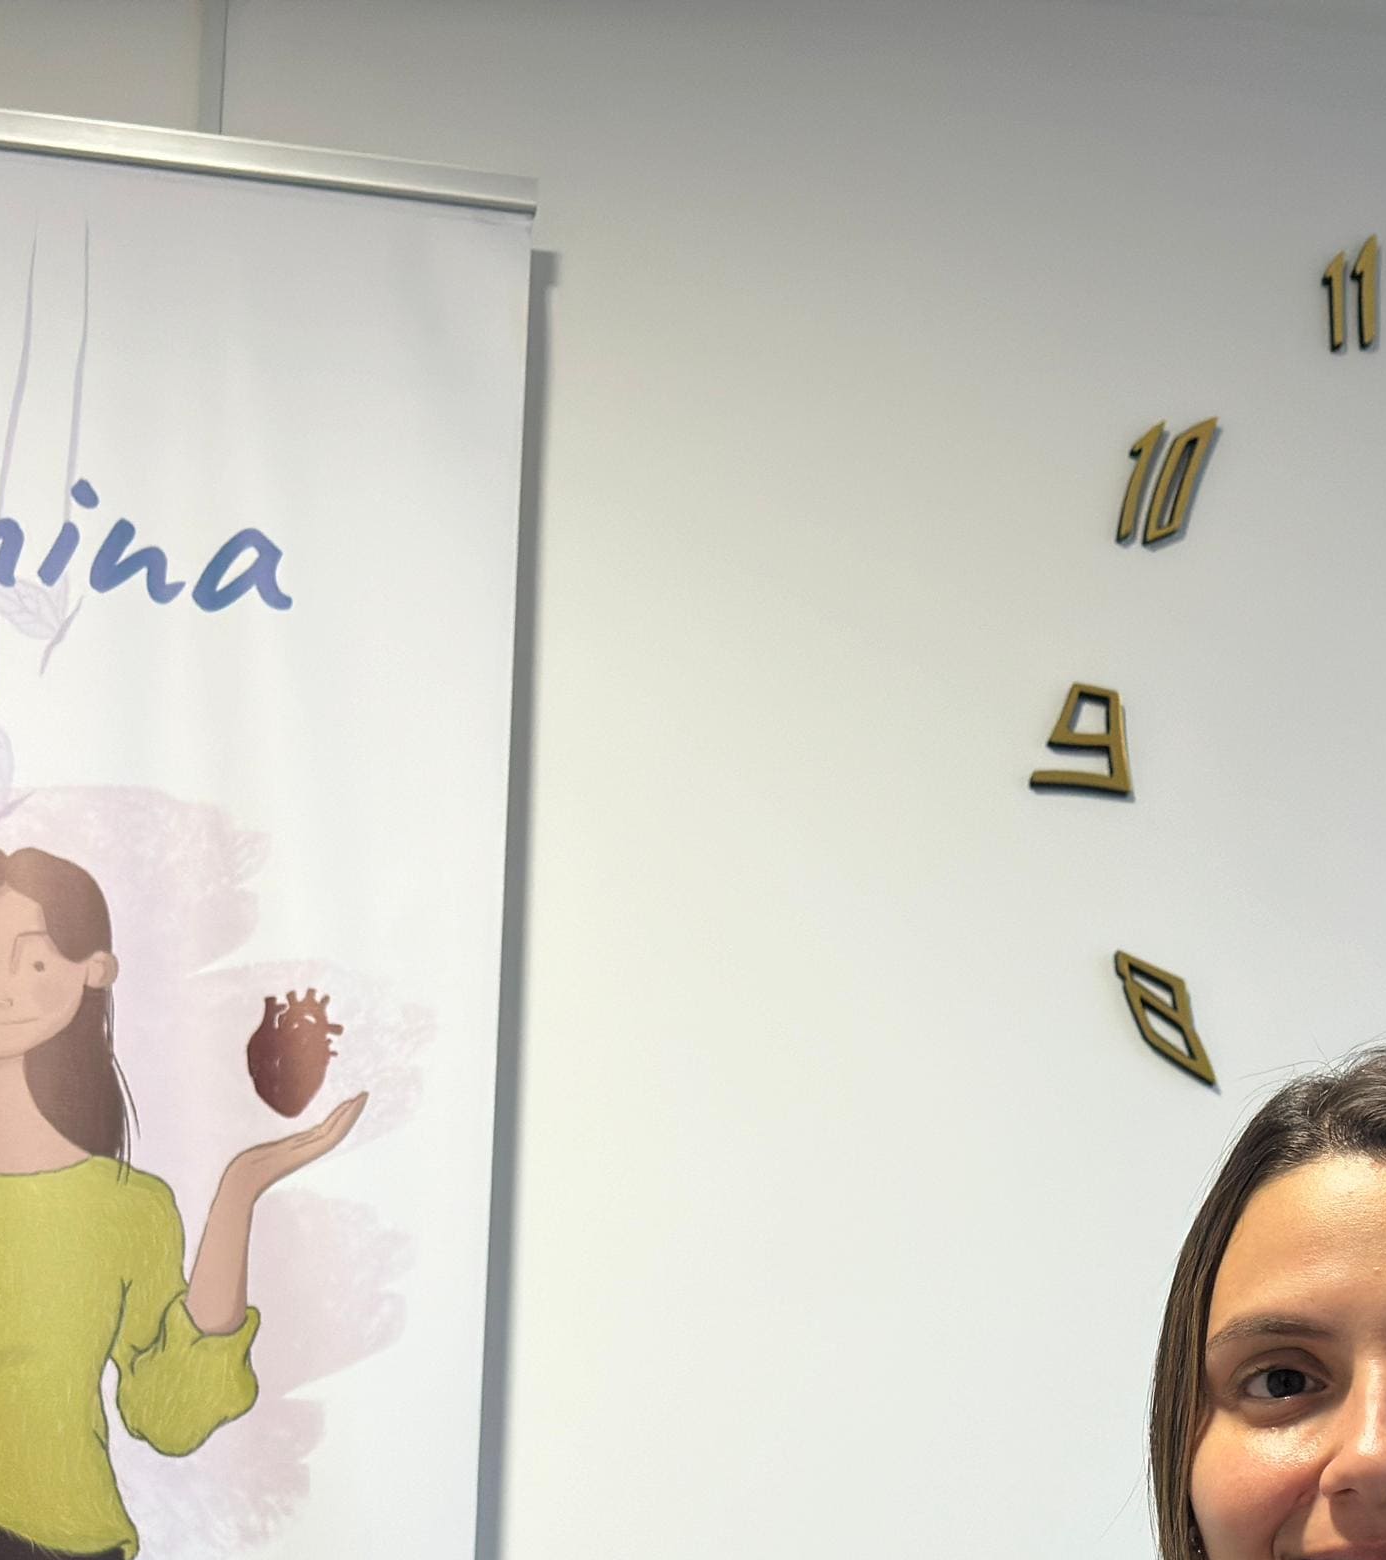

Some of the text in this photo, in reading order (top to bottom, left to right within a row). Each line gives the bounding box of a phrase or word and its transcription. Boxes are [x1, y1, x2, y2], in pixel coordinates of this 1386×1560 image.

[1323, 234, 1378, 351] 11
[1116, 417, 1218, 547] 10
[1030, 682, 1131, 795] 9
[1114, 949, 1217, 1086] 8
